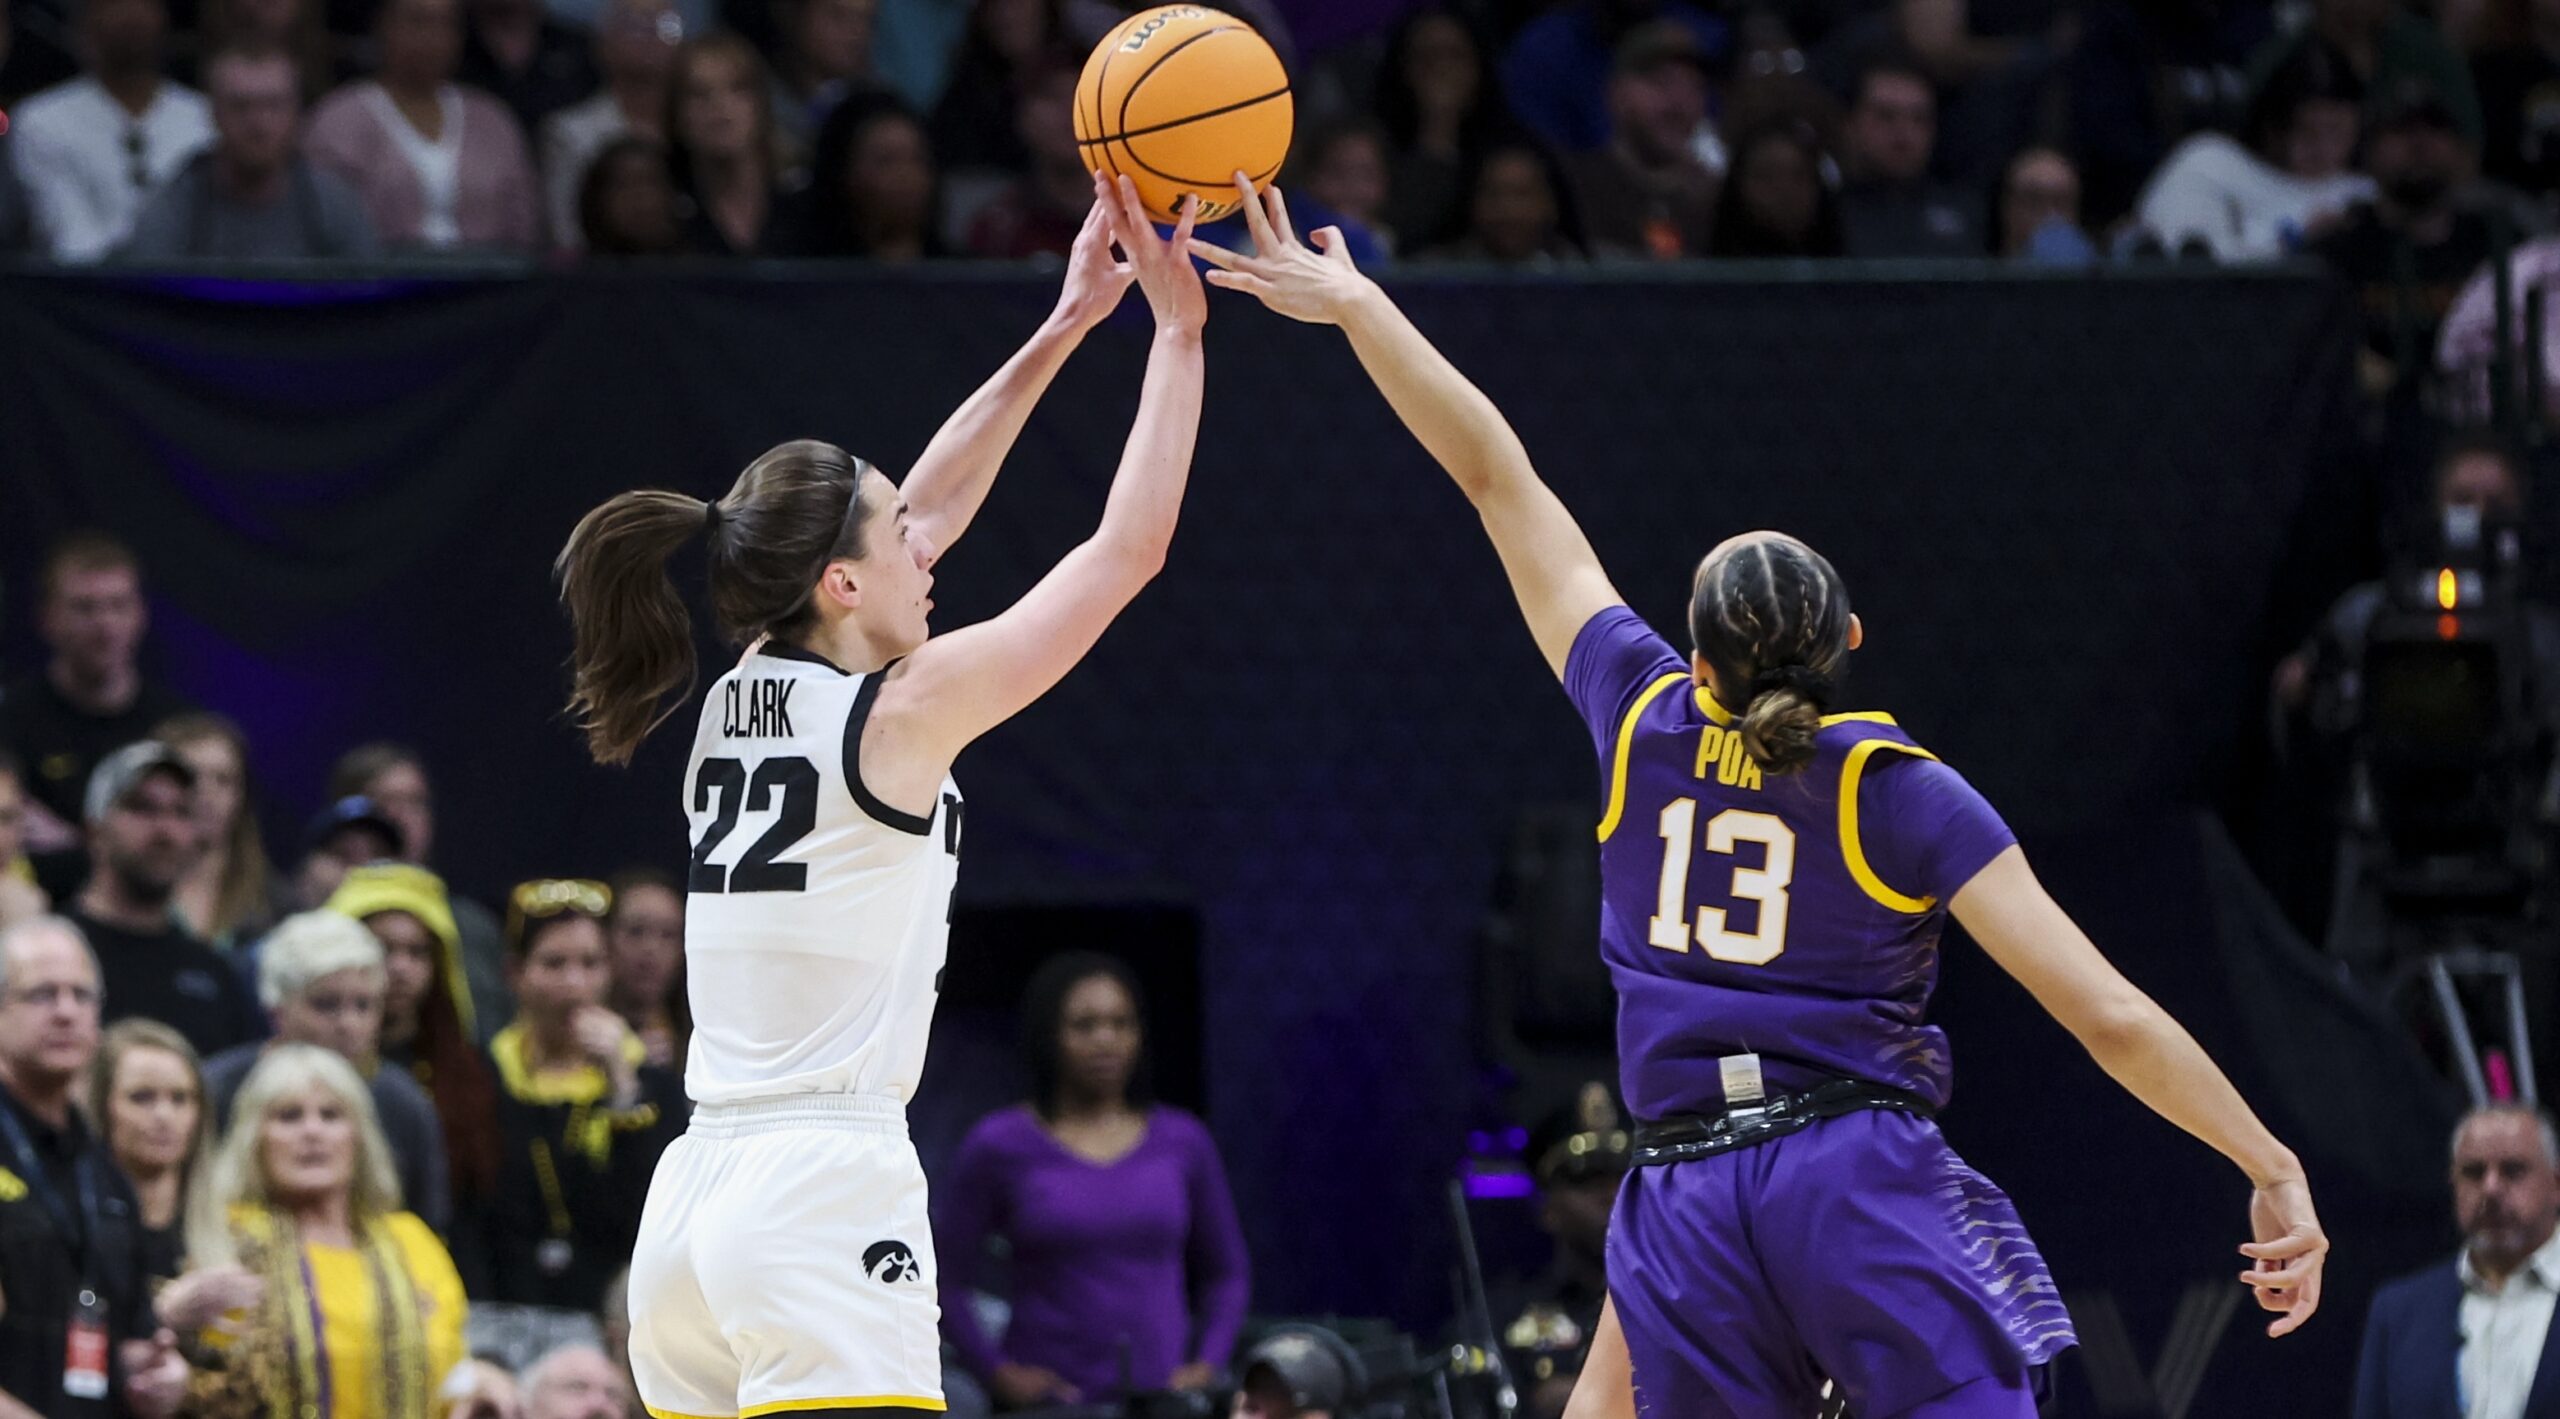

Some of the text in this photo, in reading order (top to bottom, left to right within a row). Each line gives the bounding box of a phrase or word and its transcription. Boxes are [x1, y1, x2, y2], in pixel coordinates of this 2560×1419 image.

[723, 678, 797, 738] CLARK
[1694, 725, 1762, 791] POA
[688, 756, 820, 894] 22
[1648, 797, 1796, 966] 13
